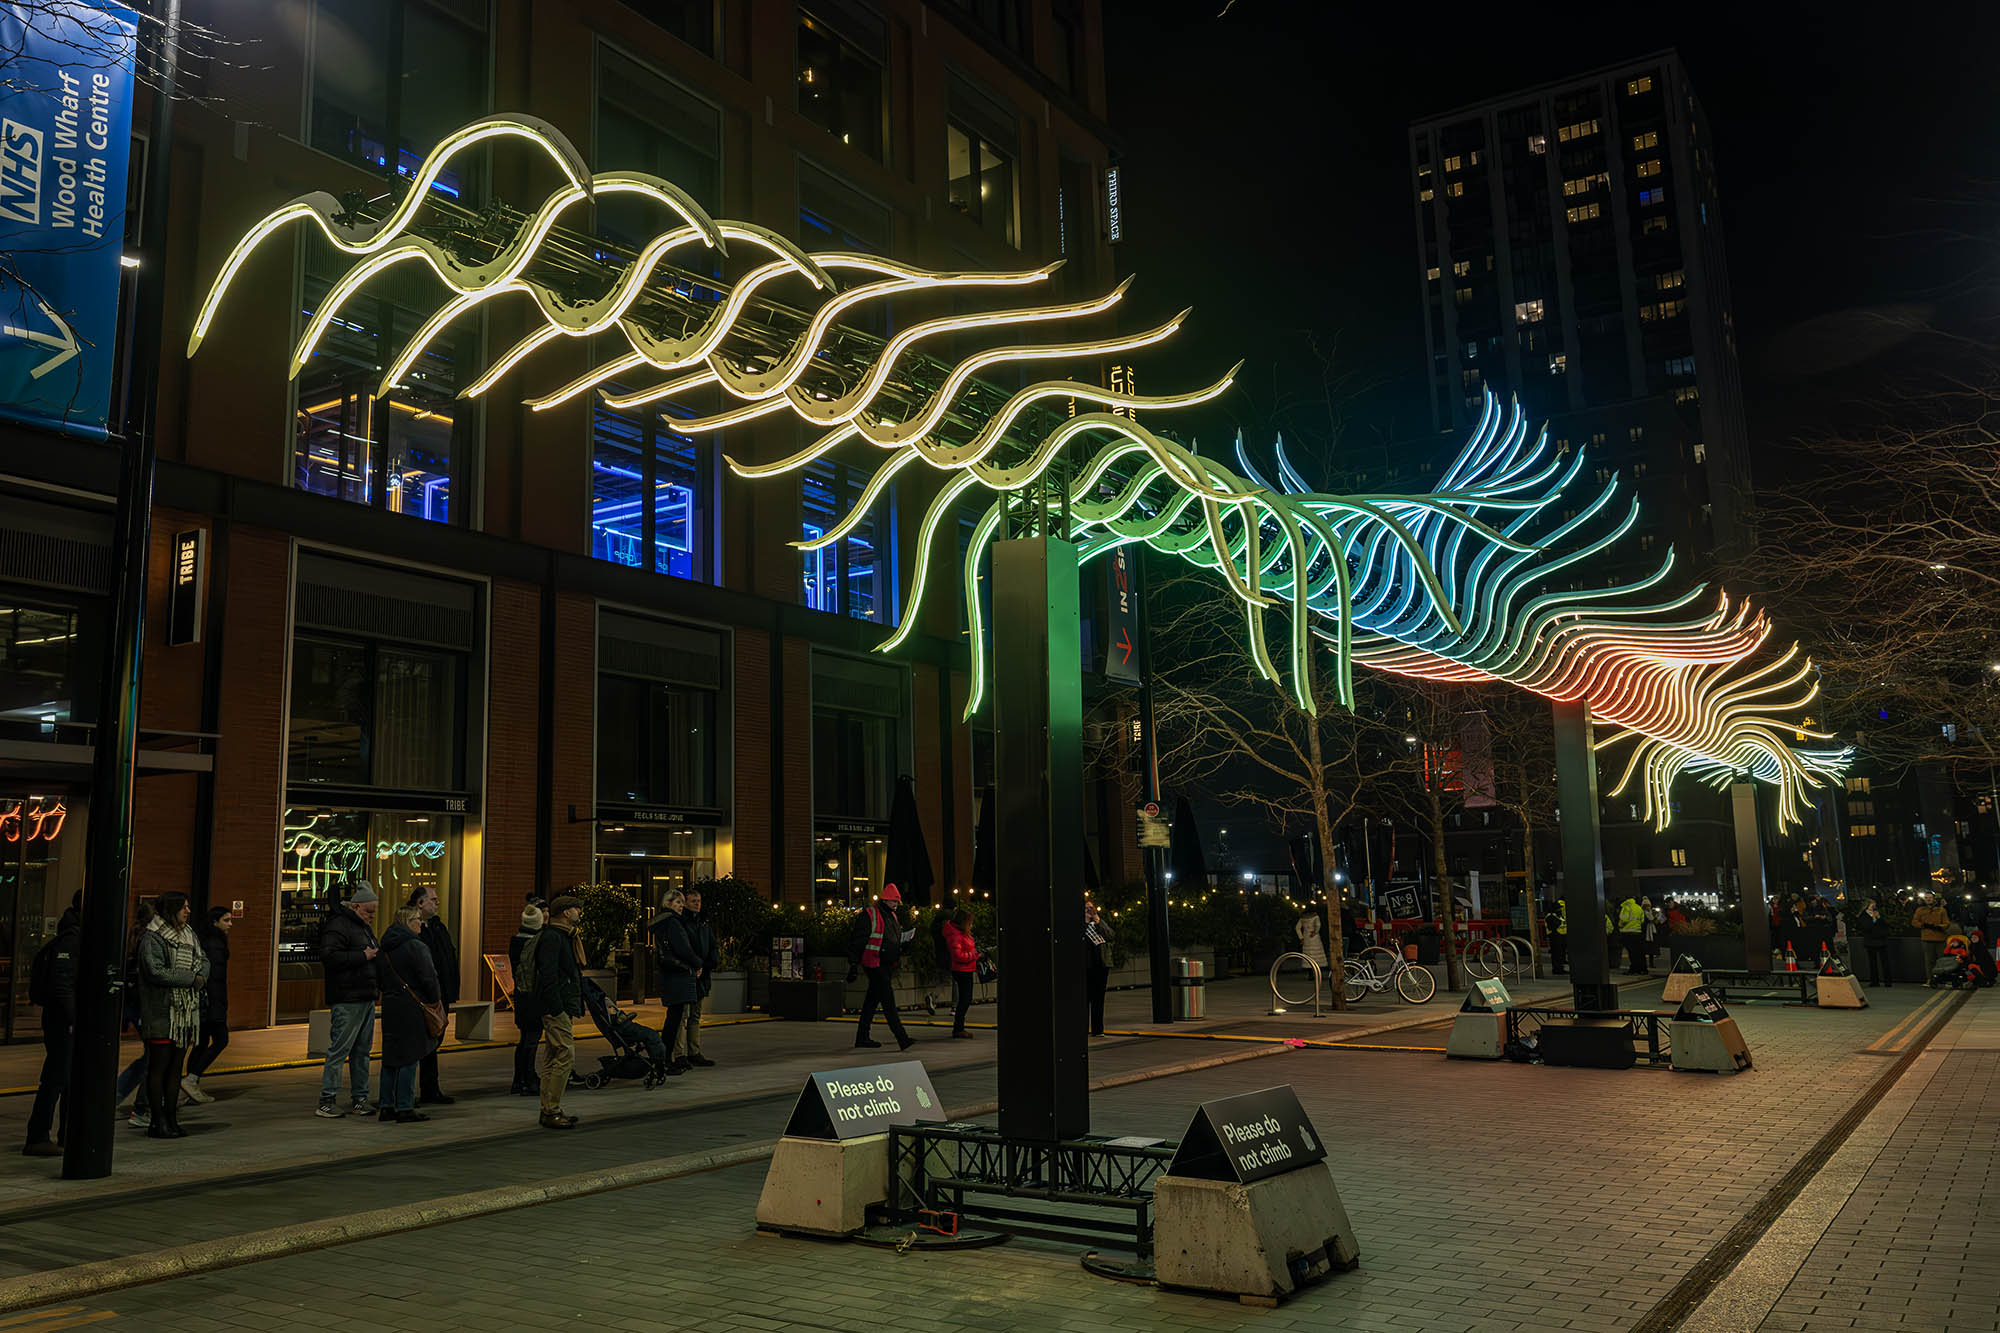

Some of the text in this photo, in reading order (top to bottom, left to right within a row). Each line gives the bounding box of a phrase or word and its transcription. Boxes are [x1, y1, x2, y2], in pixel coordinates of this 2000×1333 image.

[52, 70, 80, 228] Wood Wharf
[82, 73, 110, 238] Health Centre
[0, 119, 43, 224] NHS
[1108, 170, 1120, 240] THIRD SPACE
[179, 540, 195, 585] TRIBE
[446, 799, 466, 811] TRIBE
[826, 1075, 894, 1099] Please do
[837, 1096, 901, 1121] not climb
[1222, 1113, 1281, 1145] Please do
[1238, 1138, 1292, 1171] not climb
